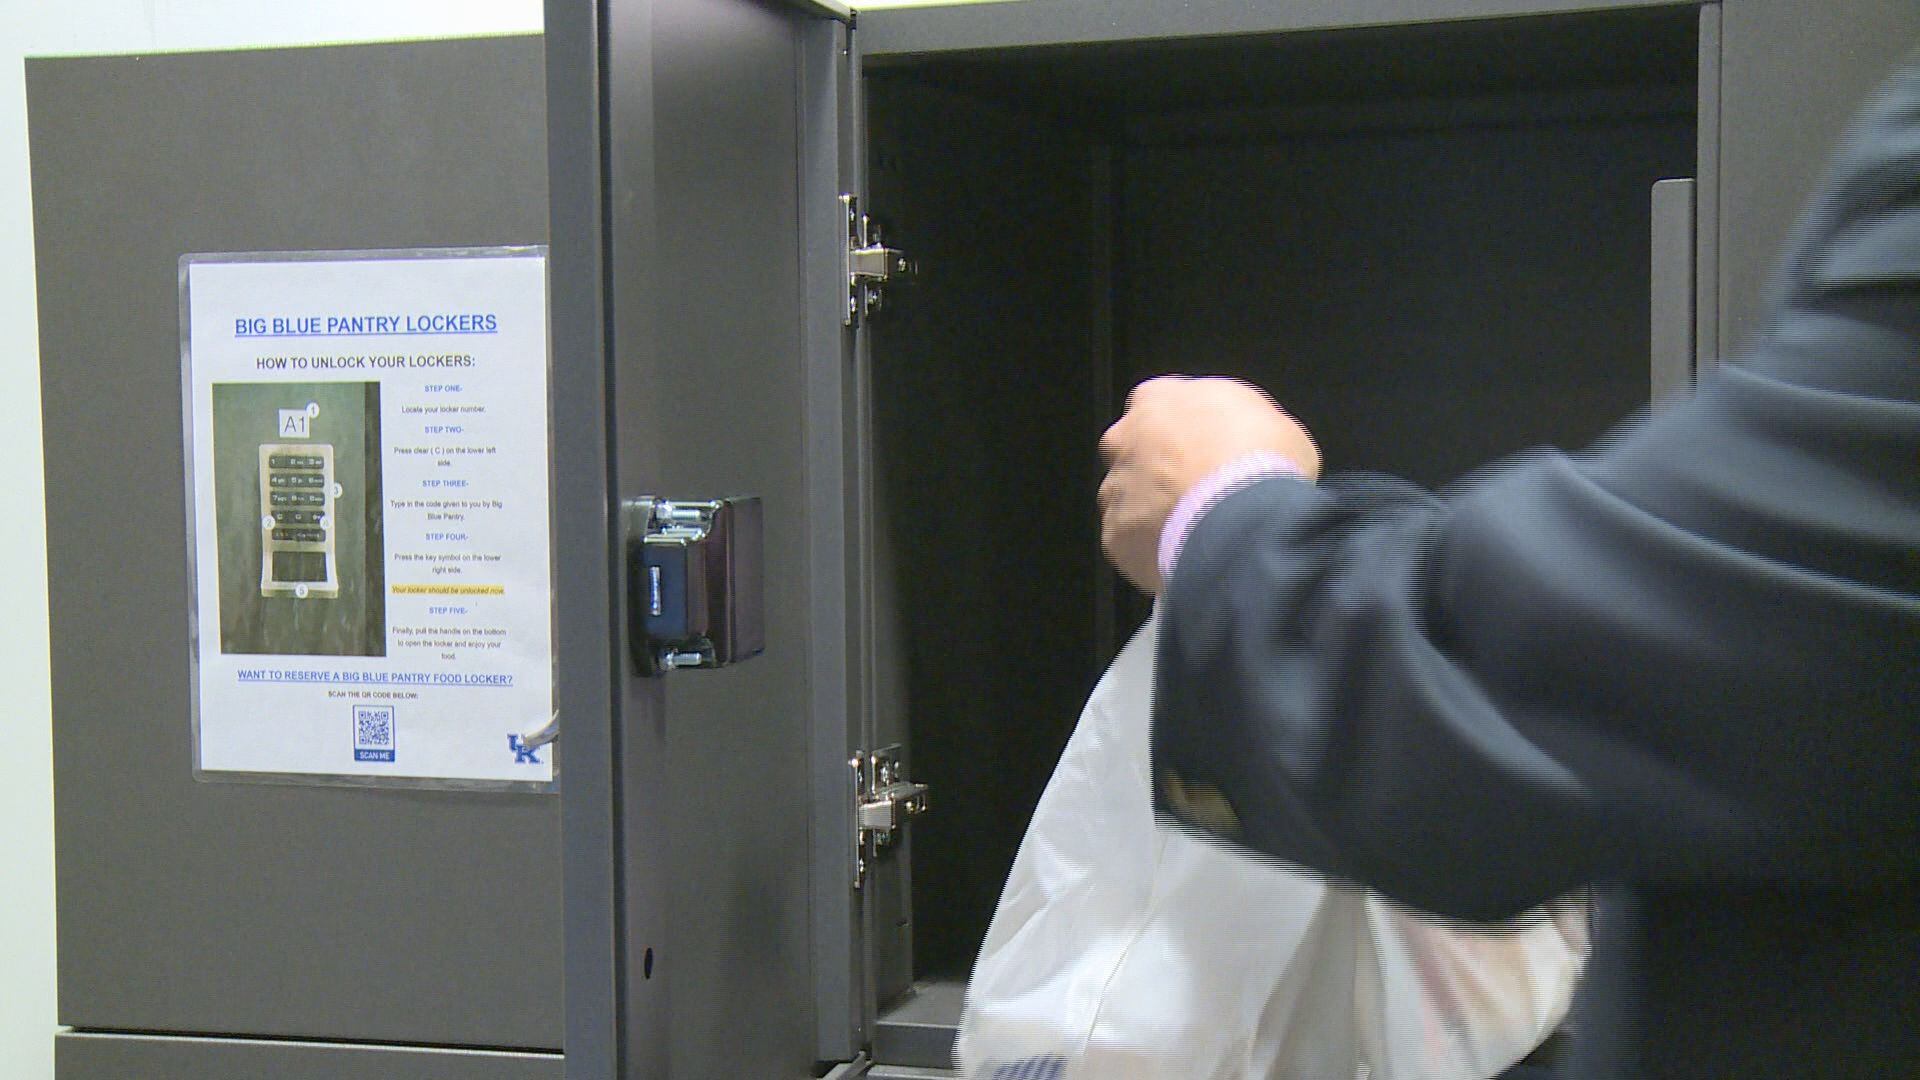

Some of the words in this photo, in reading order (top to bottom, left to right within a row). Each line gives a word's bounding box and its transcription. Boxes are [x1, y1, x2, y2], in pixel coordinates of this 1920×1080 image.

[235, 318, 266, 334] BIG
[272, 318, 321, 334] BLUE
[328, 316, 400, 332] PANTRY
[406, 314, 497, 331] LOCKERS
[256, 357, 288, 369] HOW
[290, 357, 308, 369] TO
[311, 356, 364, 368] UNLOCK
[369, 356, 405, 368] YOUR
[410, 355, 475, 367] LOCKERS:
[284, 416, 304, 432] A1
[392, 627, 414, 635] Finally,
[416, 627, 426, 635] pull
[238, 670, 267, 680] WANT
[270, 670, 283, 680] TO
[285, 671, 330, 681] RESERVE
[333, 672, 340, 681] A
[342, 672, 359, 681] BIG
[363, 672, 388, 682] BLUE
[391, 673, 430, 682] PANTRY
[434, 673, 461, 683] FOOD
[465, 674, 512, 684] LOCKER?
